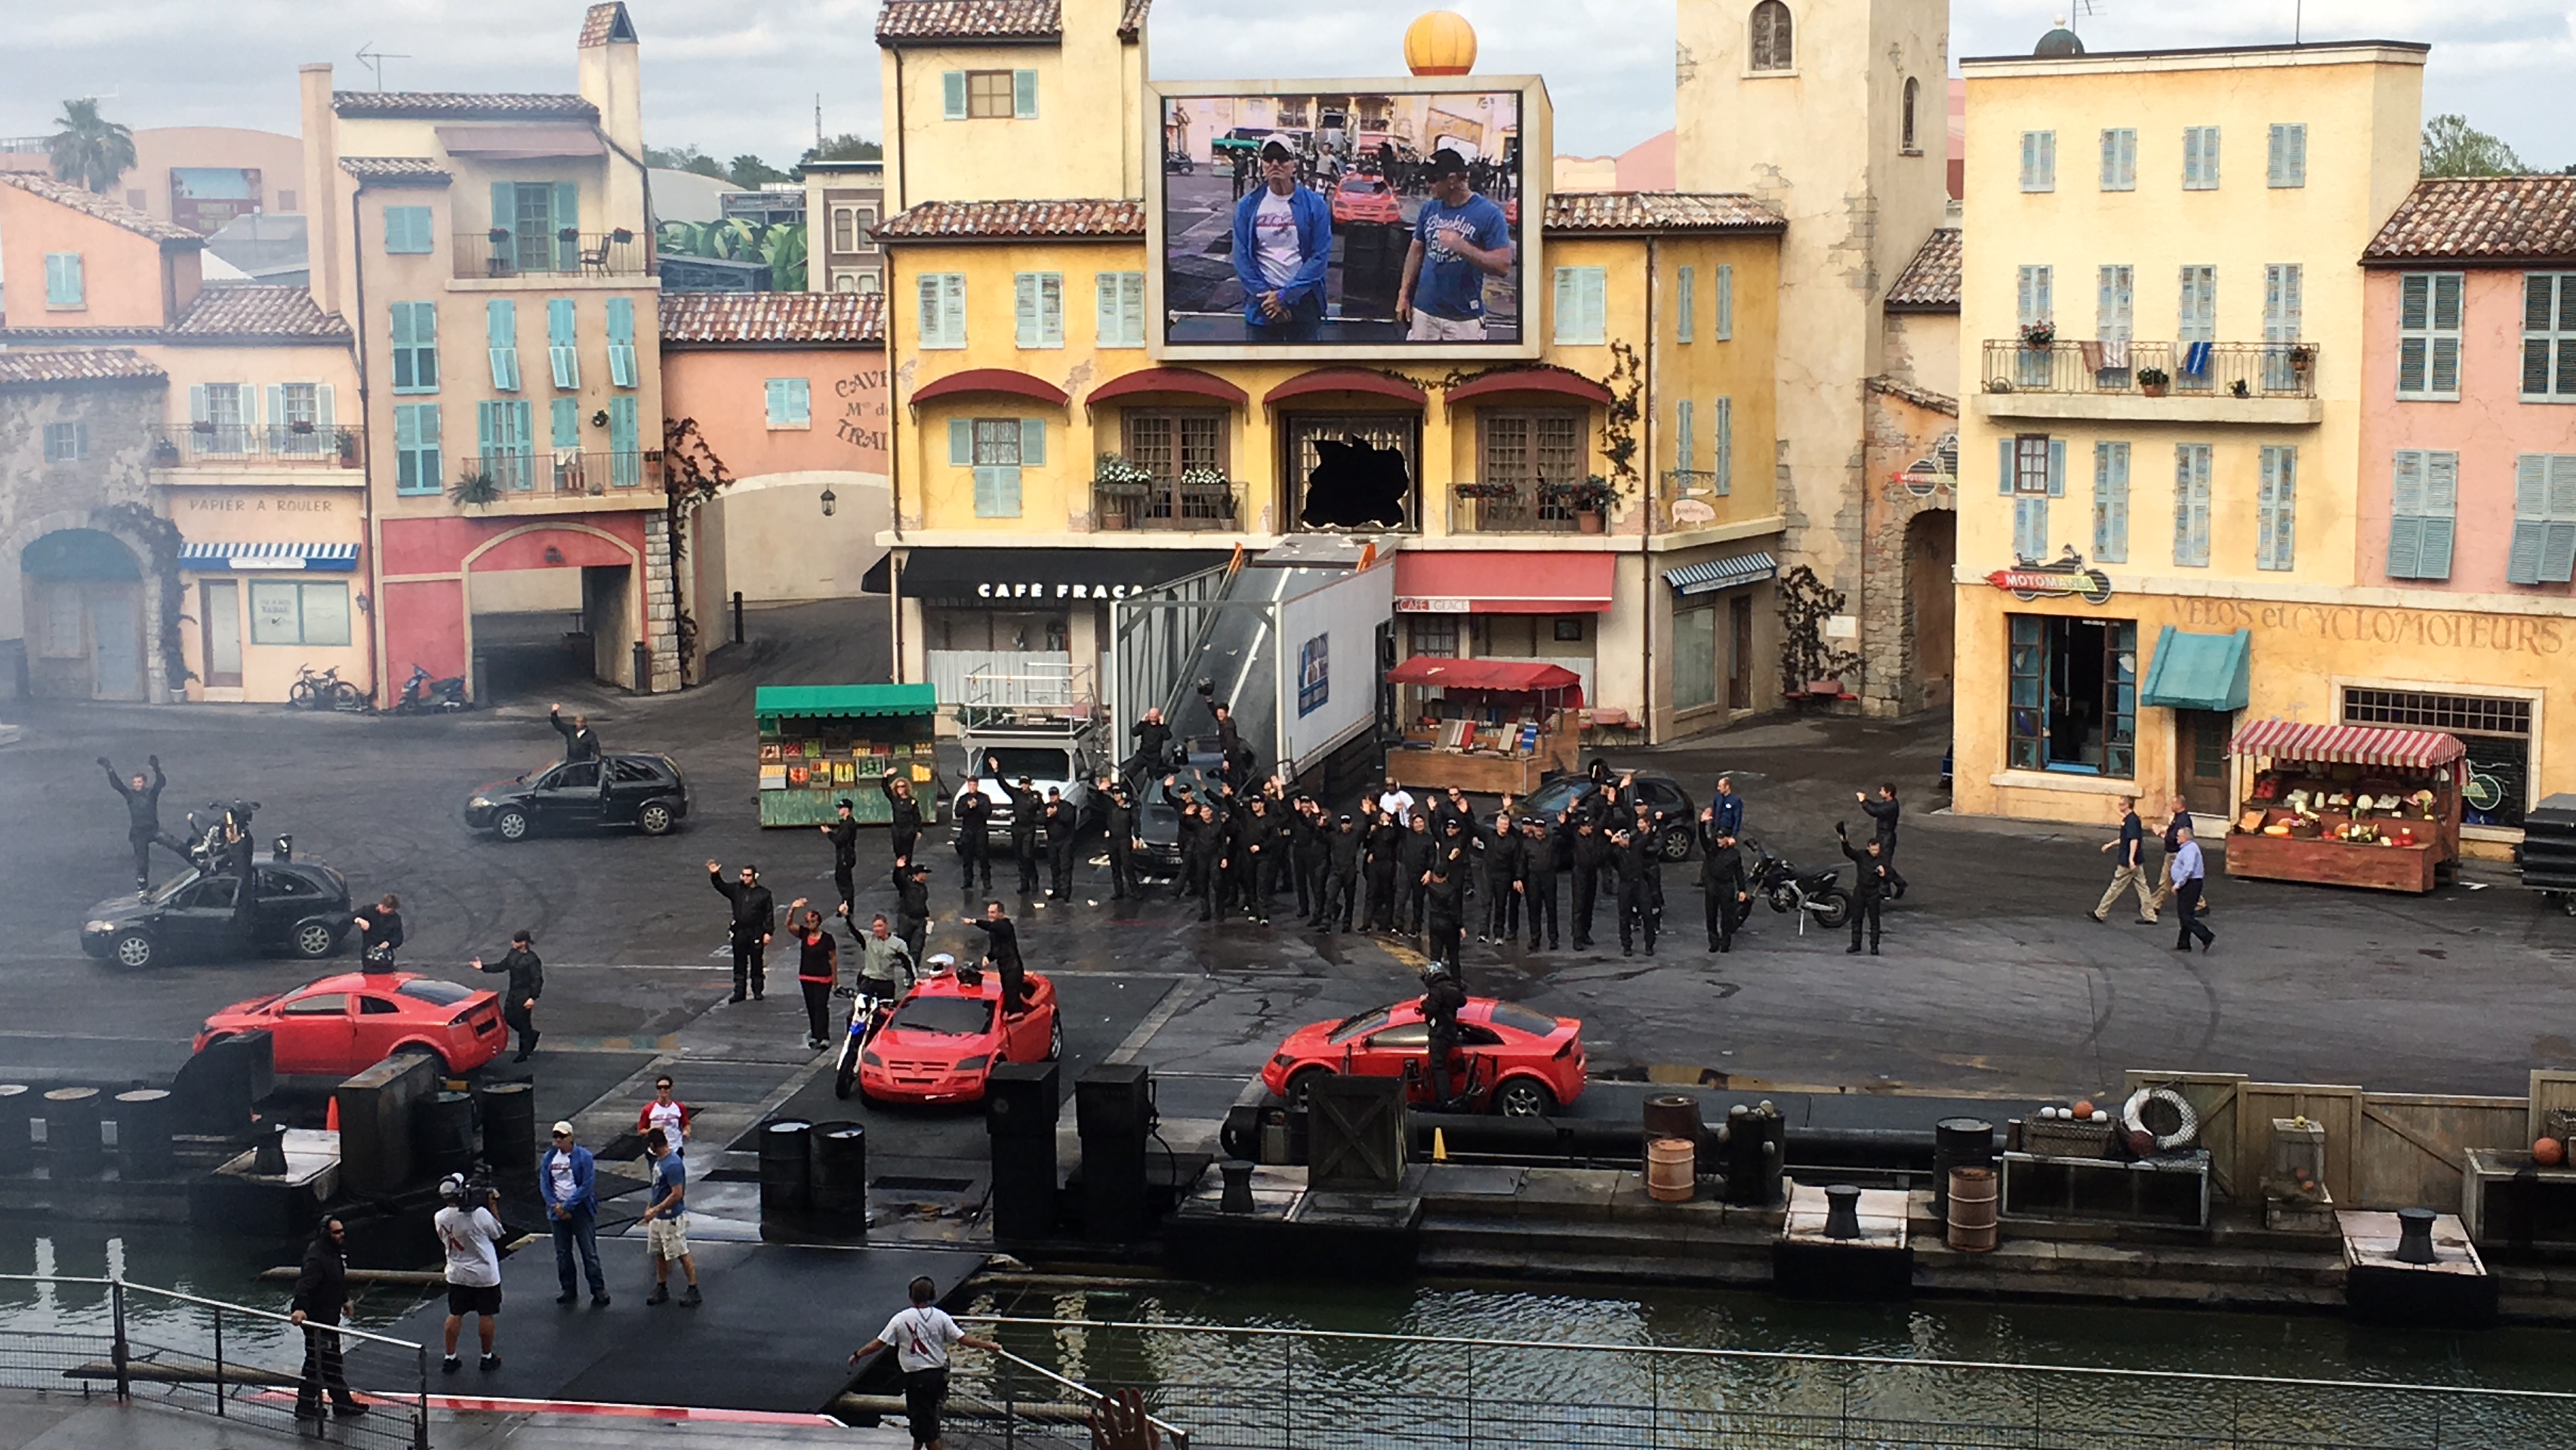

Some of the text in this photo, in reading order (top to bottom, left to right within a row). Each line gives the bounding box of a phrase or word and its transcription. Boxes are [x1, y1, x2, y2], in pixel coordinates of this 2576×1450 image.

[1425, 214, 1476, 240] Brooklyn
[190, 499, 333, 511] PAPIER A ROULER
[2004, 574, 2094, 589] MOTOMANIA
[2260, 603, 2288, 630] et
[2292, 606, 2563, 657] CYCLOMOTEURS
